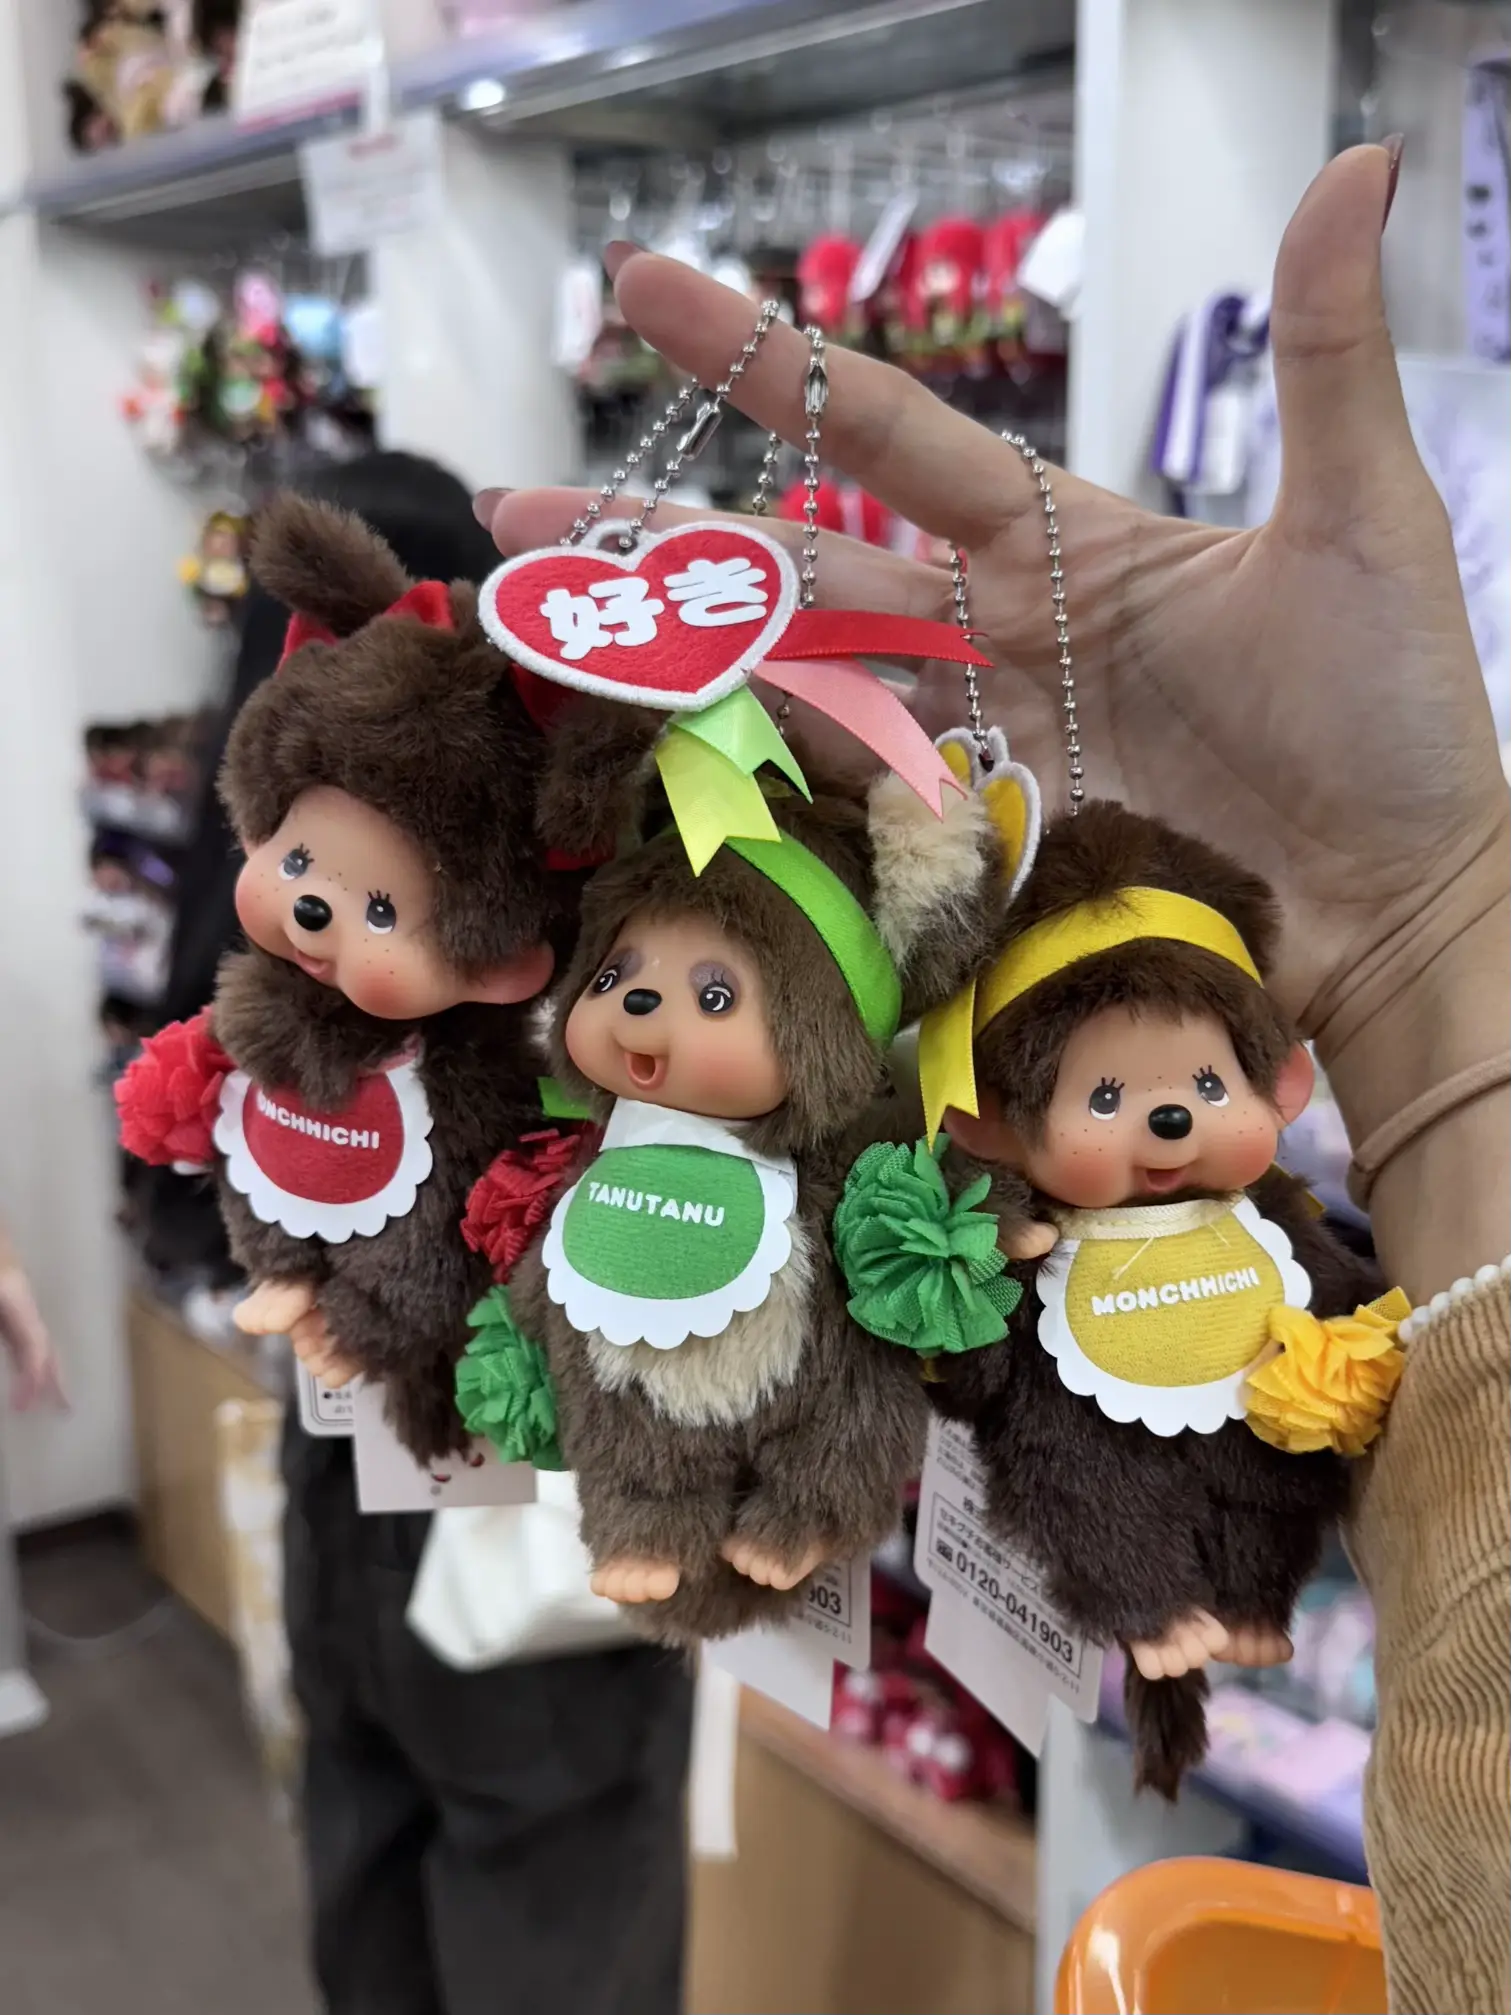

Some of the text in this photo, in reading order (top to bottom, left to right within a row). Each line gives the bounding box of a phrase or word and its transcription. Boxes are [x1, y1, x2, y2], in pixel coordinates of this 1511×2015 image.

[539, 557, 769, 660] 好き
[256, 1088, 381, 1150] ONCHHICHI
[588, 1181, 725, 1227] TANUTANU
[1091, 1266, 1261, 1316] MONCHHICHI
[956, 1551, 1074, 1664] 0120-041903
